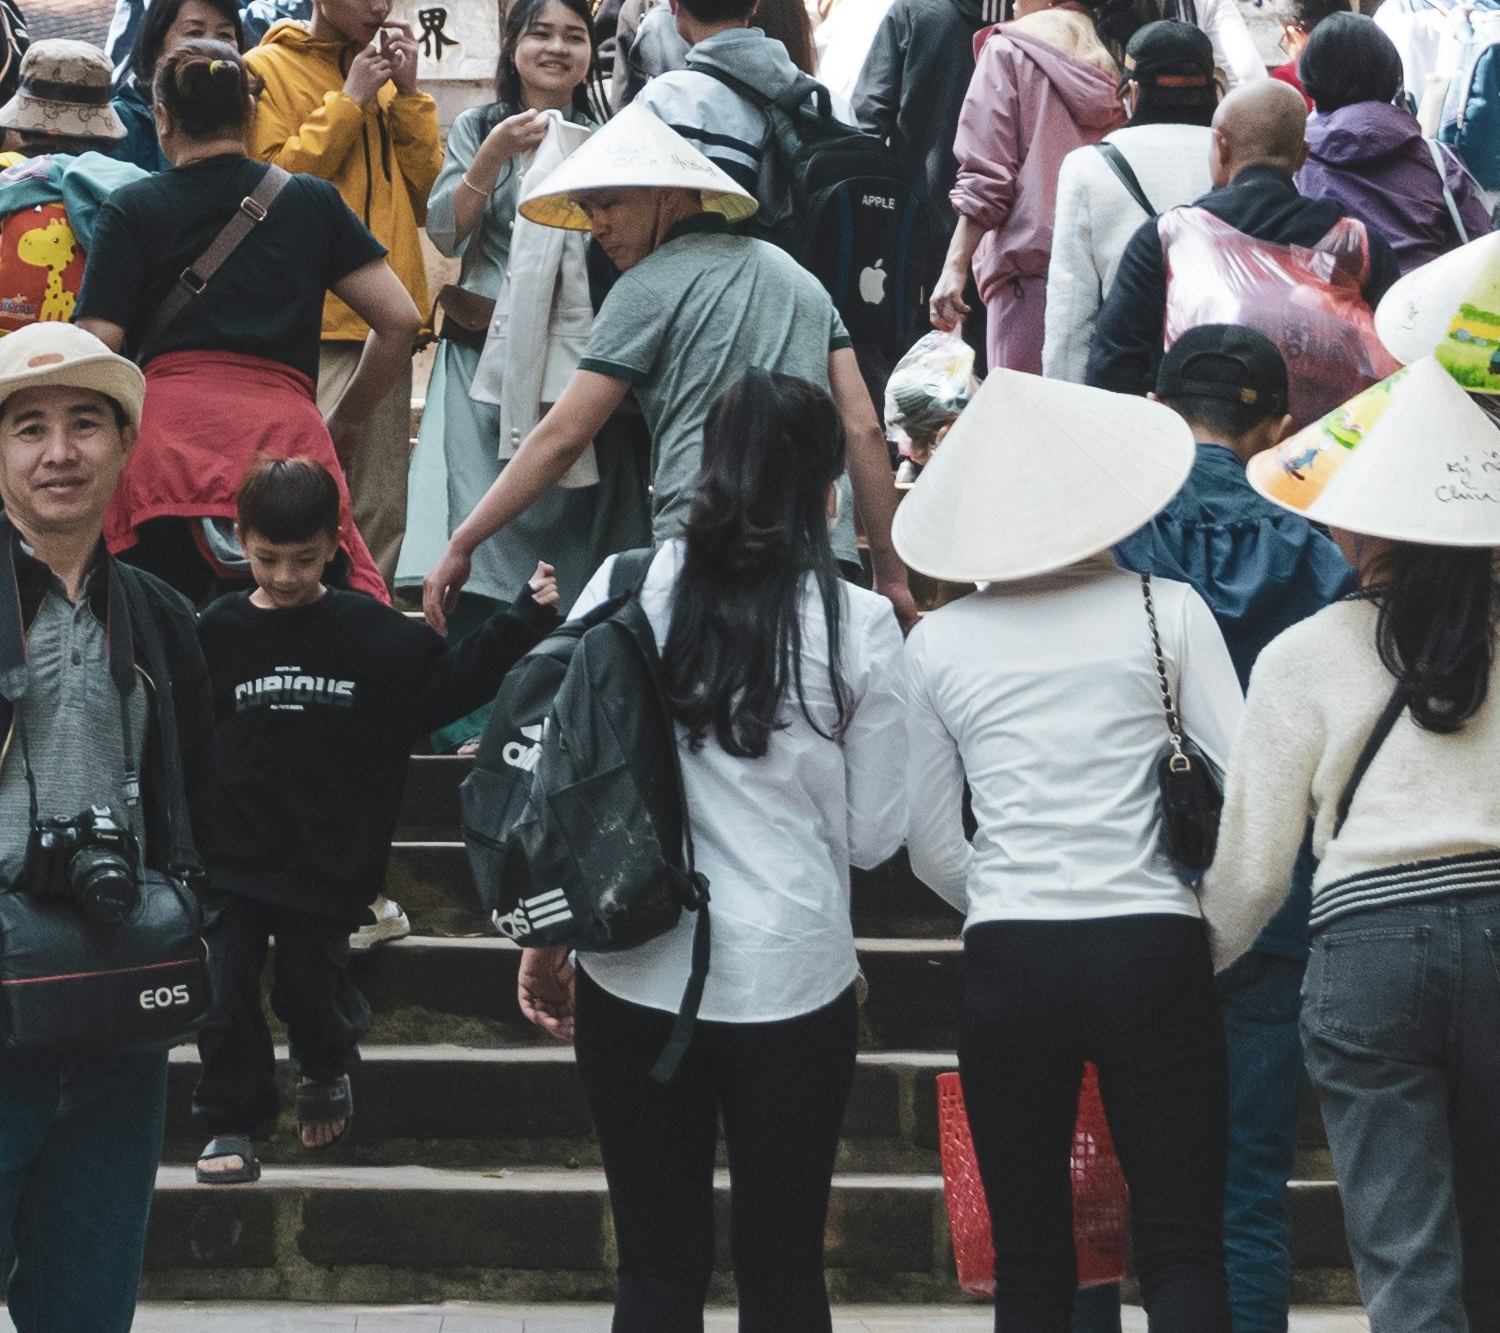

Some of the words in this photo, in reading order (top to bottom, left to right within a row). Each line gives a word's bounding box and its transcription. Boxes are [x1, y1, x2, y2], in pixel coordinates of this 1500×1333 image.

[861, 194, 896, 210] APPLE
[234, 674, 357, 711] CURIOUS
[139, 984, 190, 1010] EOS
